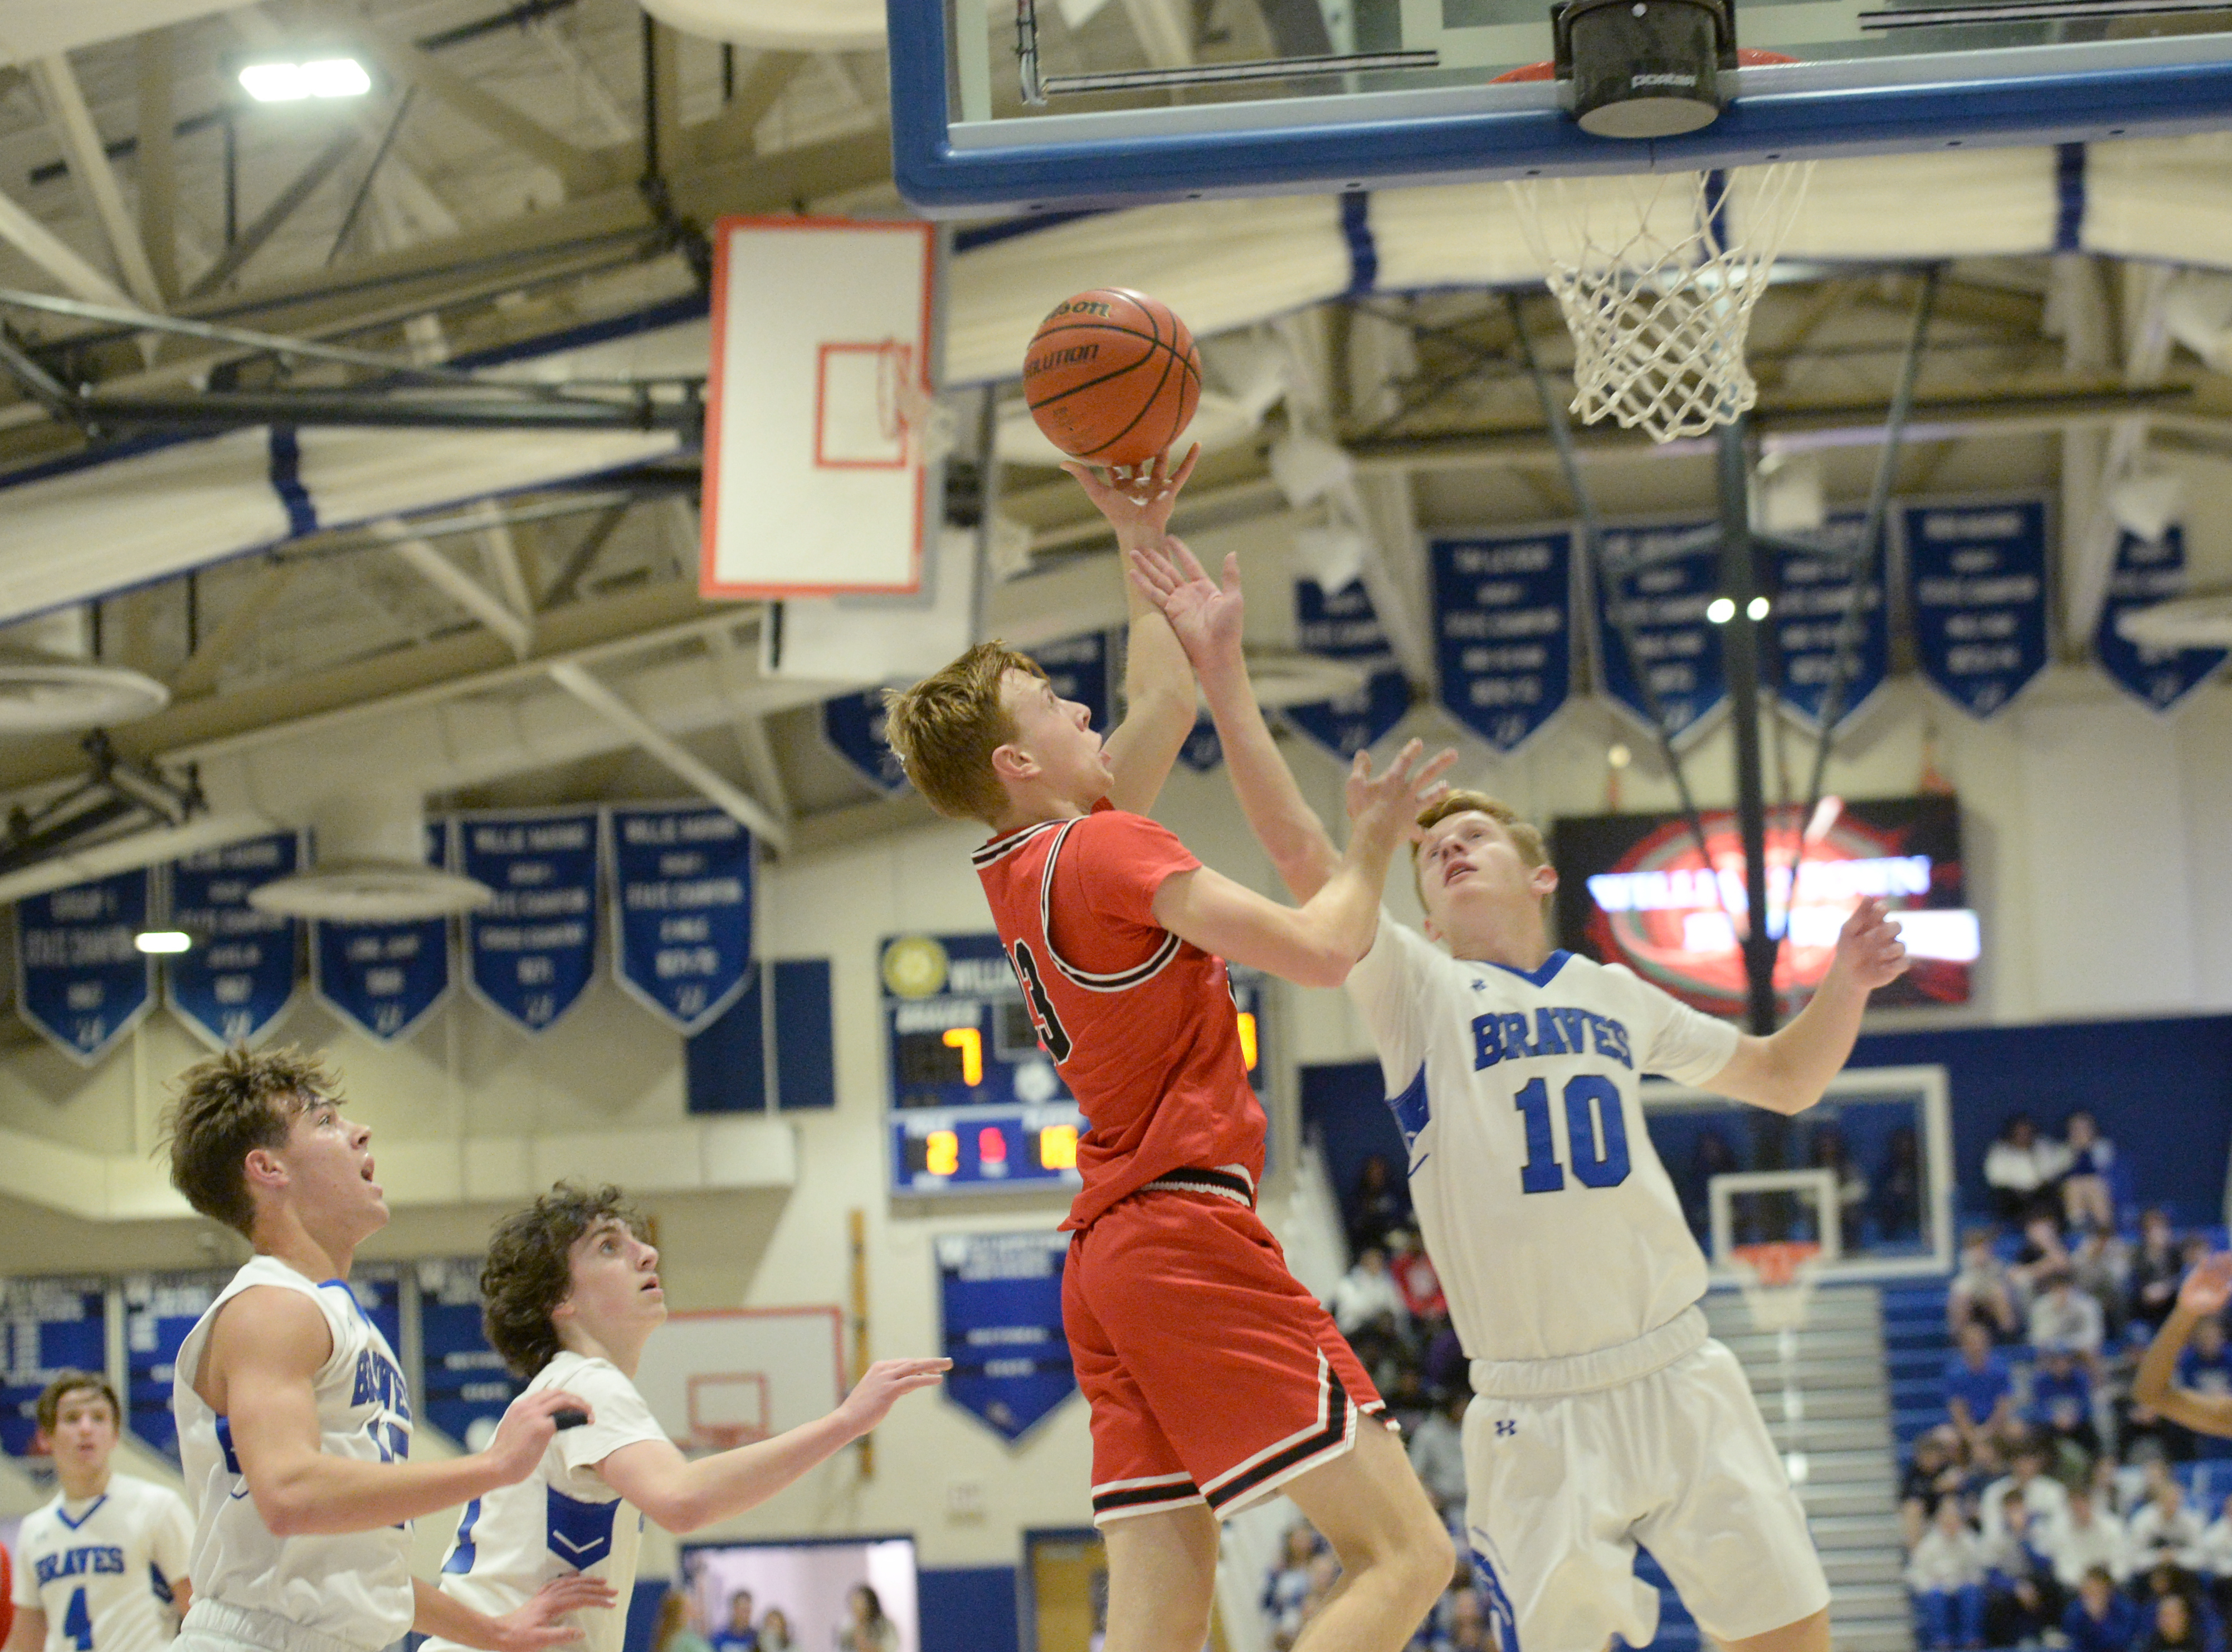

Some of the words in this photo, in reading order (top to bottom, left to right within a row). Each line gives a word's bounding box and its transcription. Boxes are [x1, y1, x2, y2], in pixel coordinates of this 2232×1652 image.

[1003, 938, 1073, 1066] 3
[943, 1027, 982, 1086] 7
[1471, 1007, 1633, 1071] BRAVES
[1514, 1075, 1632, 1194] 10
[35, 1545, 125, 1588] BRAVES
[64, 1587, 94, 1651] 4
